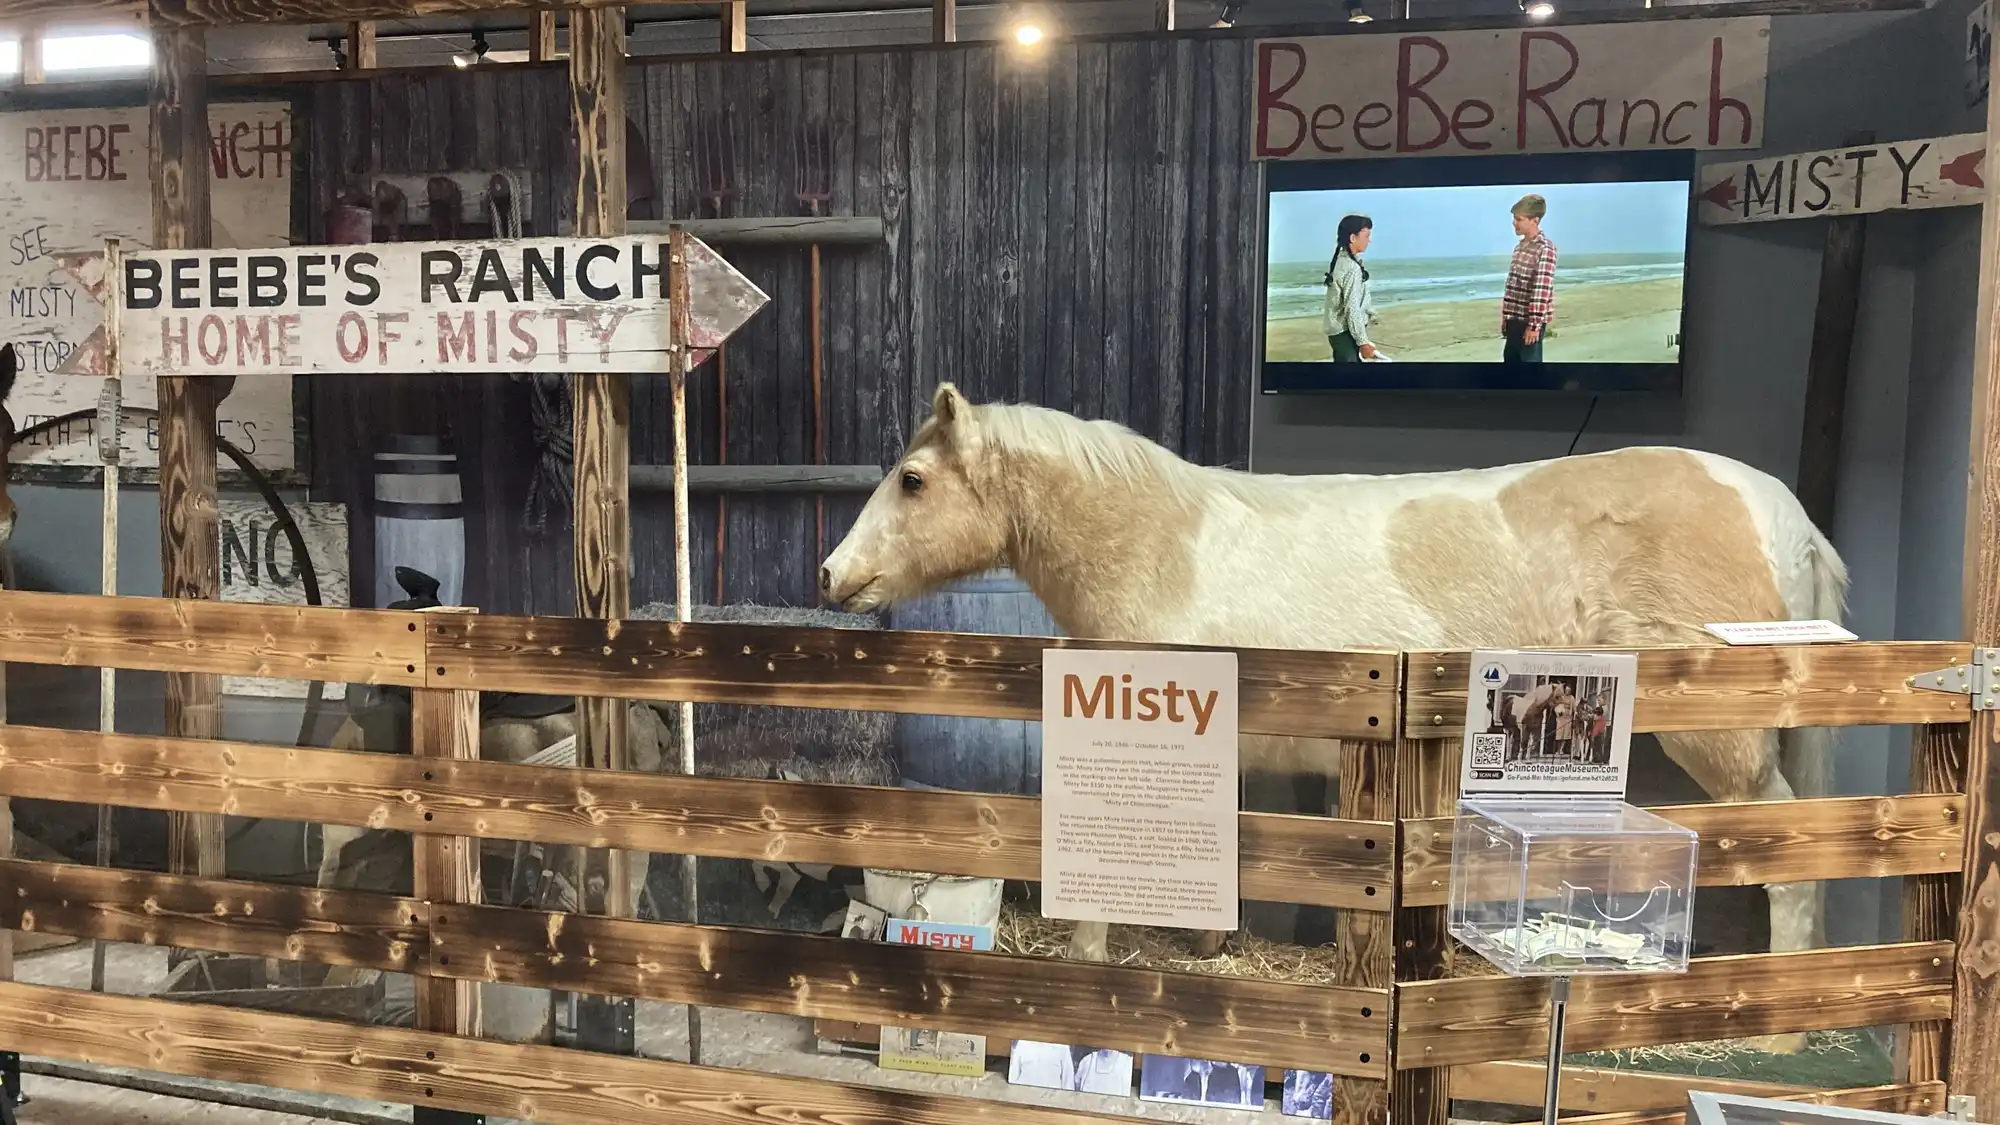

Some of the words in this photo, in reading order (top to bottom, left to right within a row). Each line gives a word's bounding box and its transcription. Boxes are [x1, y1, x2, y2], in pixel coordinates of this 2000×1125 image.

[1517, 31, 1752, 149] Ranch
[25, 123, 130, 182] BEEBE
[1743, 142, 1931, 218] MISTY
[9, 225, 53, 266] SEE
[124, 252, 381, 310] BEEBE'S
[420, 243, 671, 303] RANCH
[9, 286, 77, 318] MISTY
[160, 313, 303, 367] HOME
[335, 310, 410, 367] OF
[436, 305, 630, 364] MISTY
[222, 519, 301, 588] NO
[1063, 673, 1219, 736] Misty
[1507, 762, 1619, 775] ChincoteagueMuseum.com
[900, 925, 976, 951] MISTY
